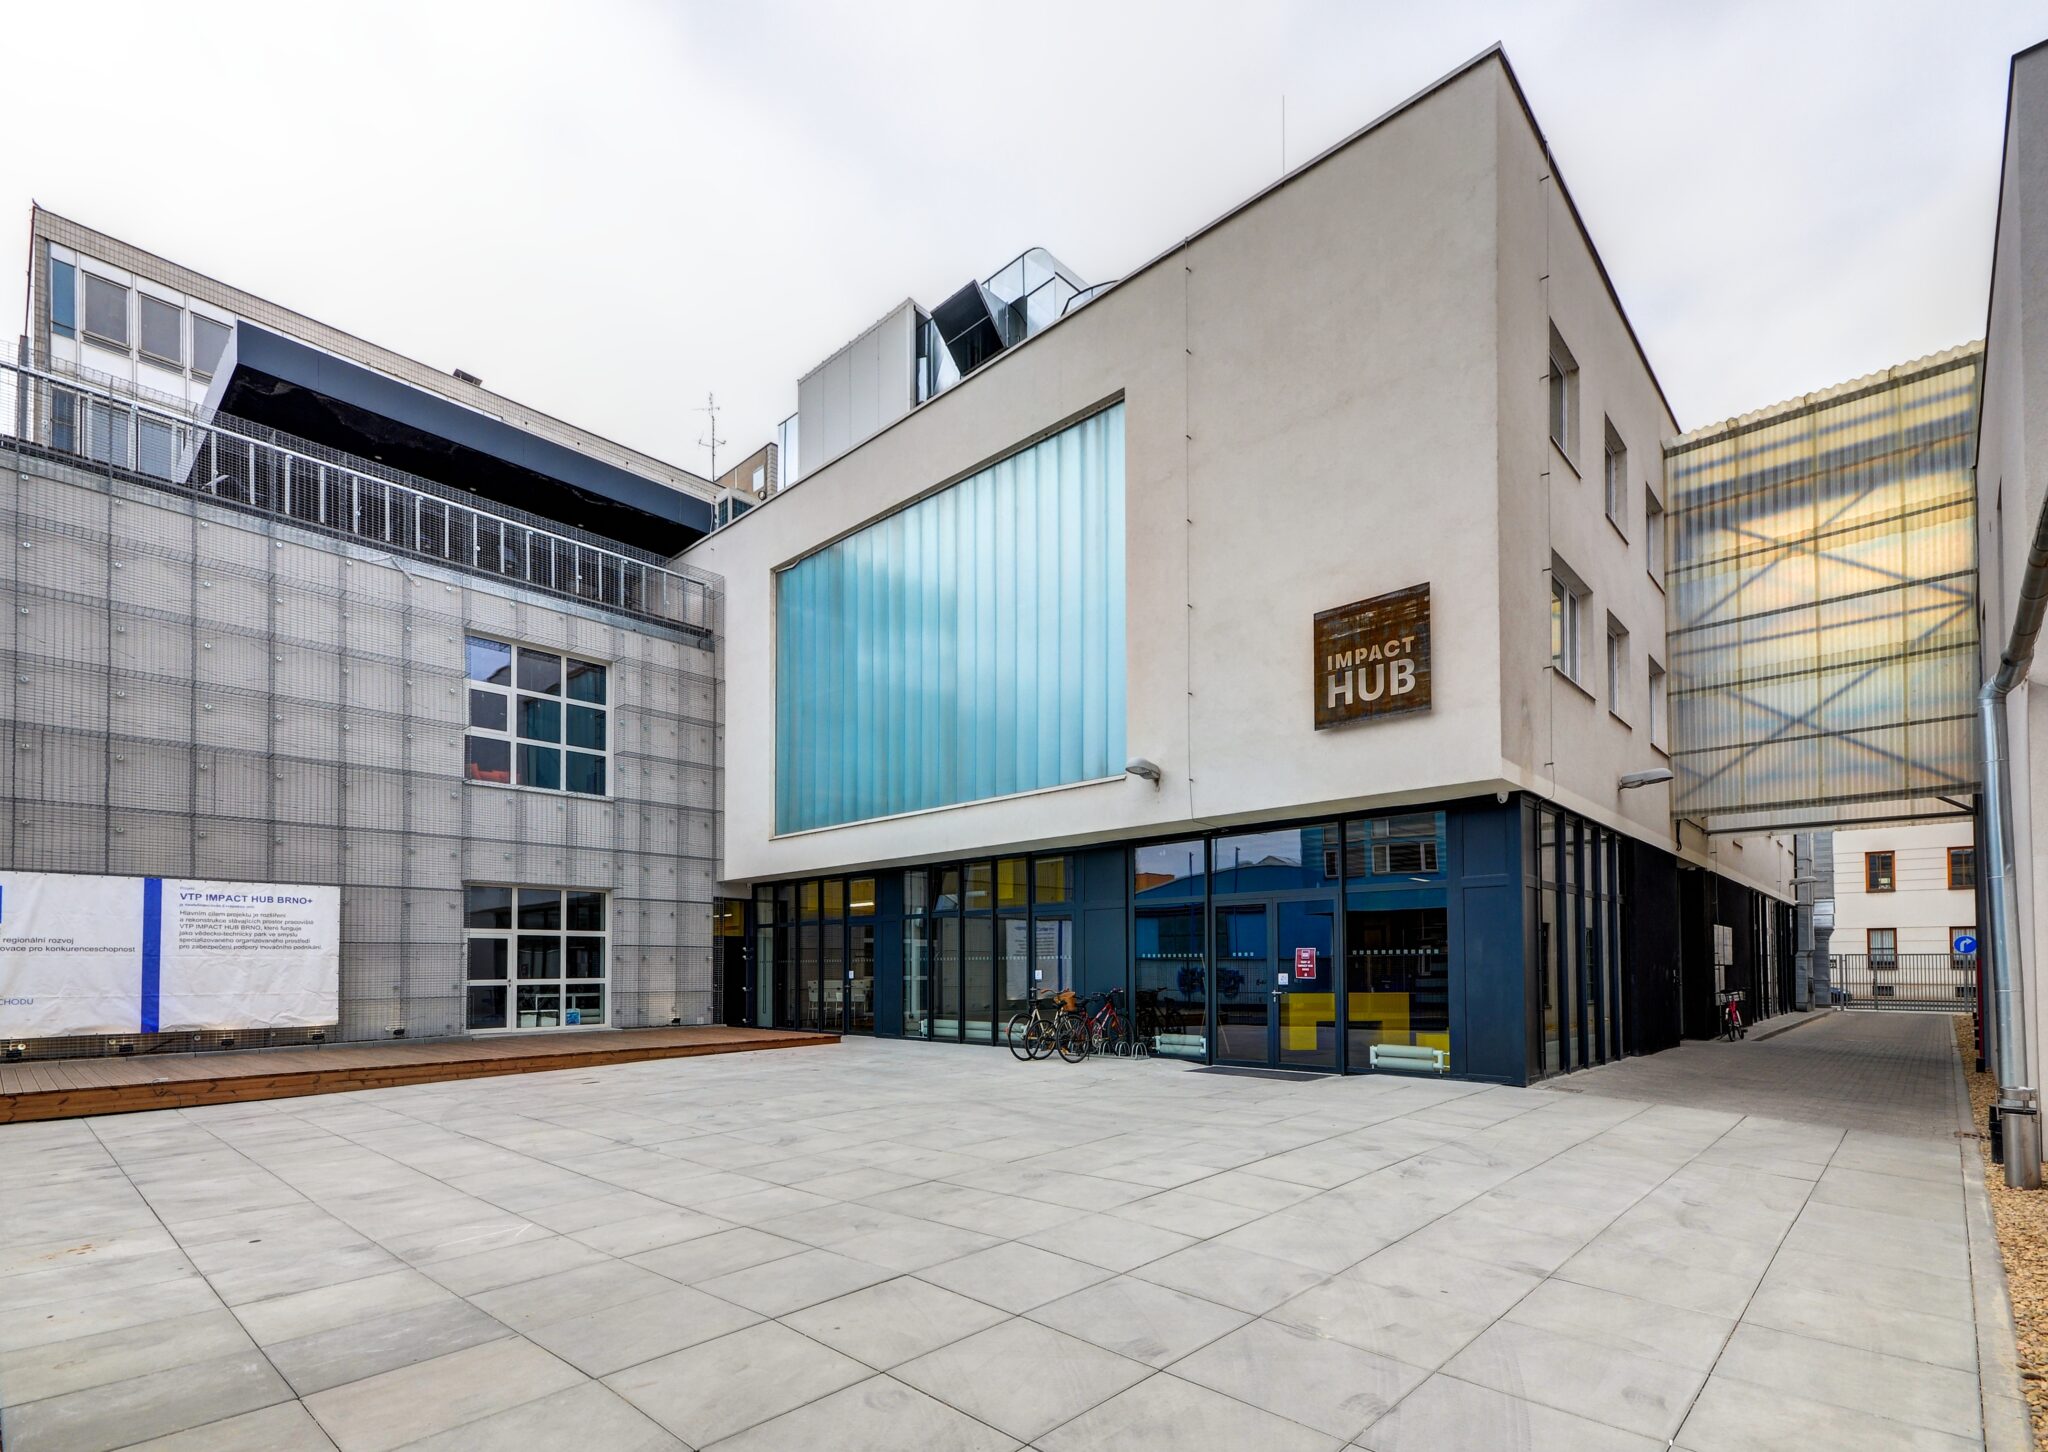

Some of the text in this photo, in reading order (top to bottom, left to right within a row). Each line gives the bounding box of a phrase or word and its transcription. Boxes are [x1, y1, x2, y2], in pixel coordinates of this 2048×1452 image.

[1327, 636, 1414, 671] IMPACT
[1327, 658, 1416, 708] HUB
[180, 893, 202, 901] VTP
[205, 894, 248, 903] IMPACT
